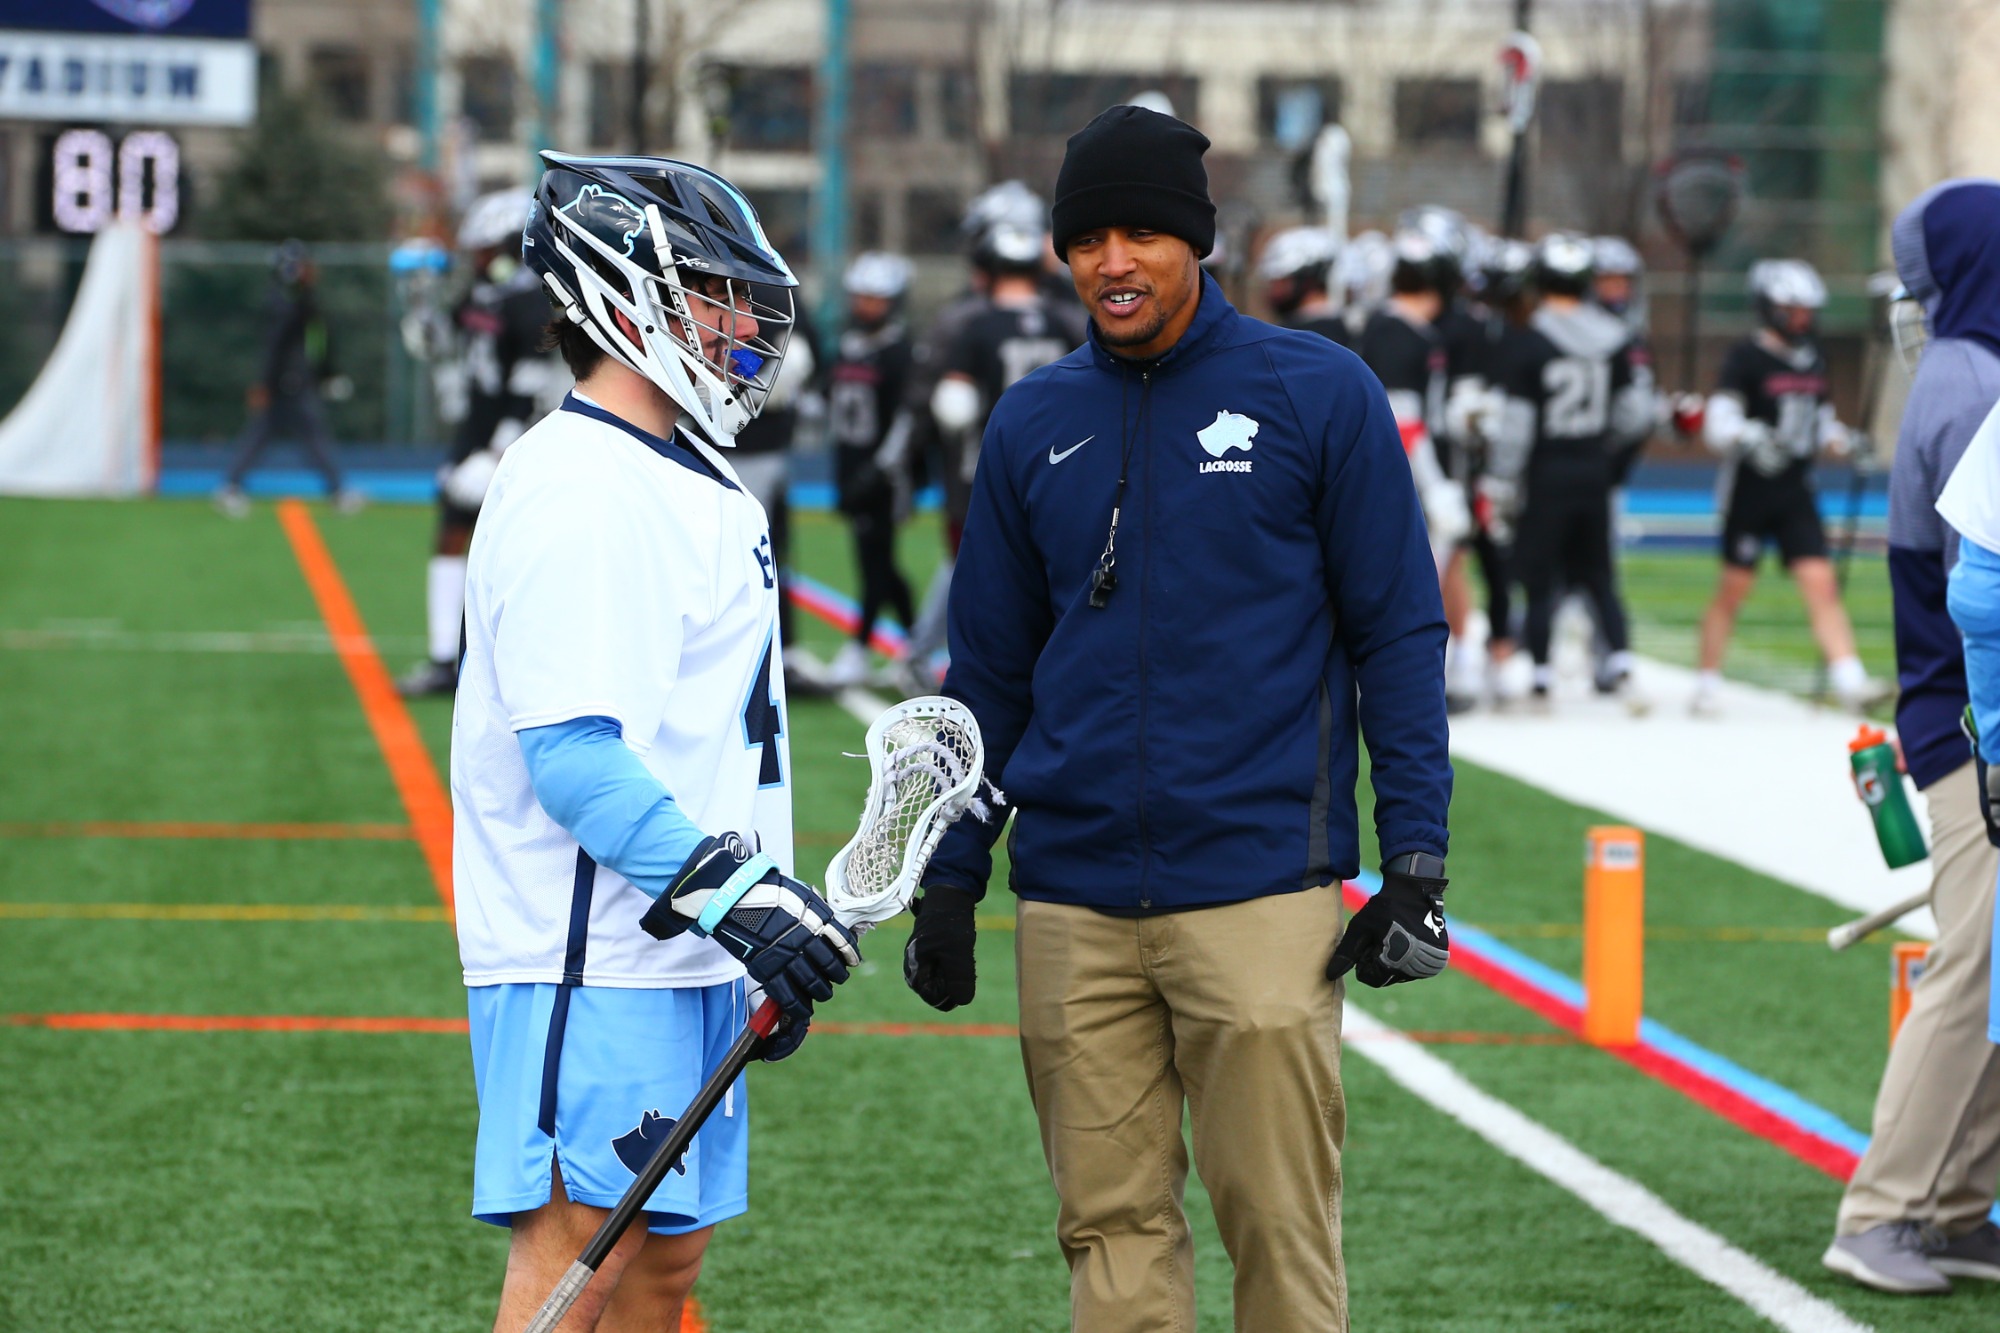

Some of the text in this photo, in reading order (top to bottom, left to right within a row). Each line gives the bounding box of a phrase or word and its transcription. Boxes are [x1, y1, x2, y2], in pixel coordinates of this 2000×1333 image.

[54, 130, 179, 234] 80
[1542, 357, 1612, 439] 21
[1199, 460, 1253, 474] LACROSSE
[1857, 769, 1886, 806] G
